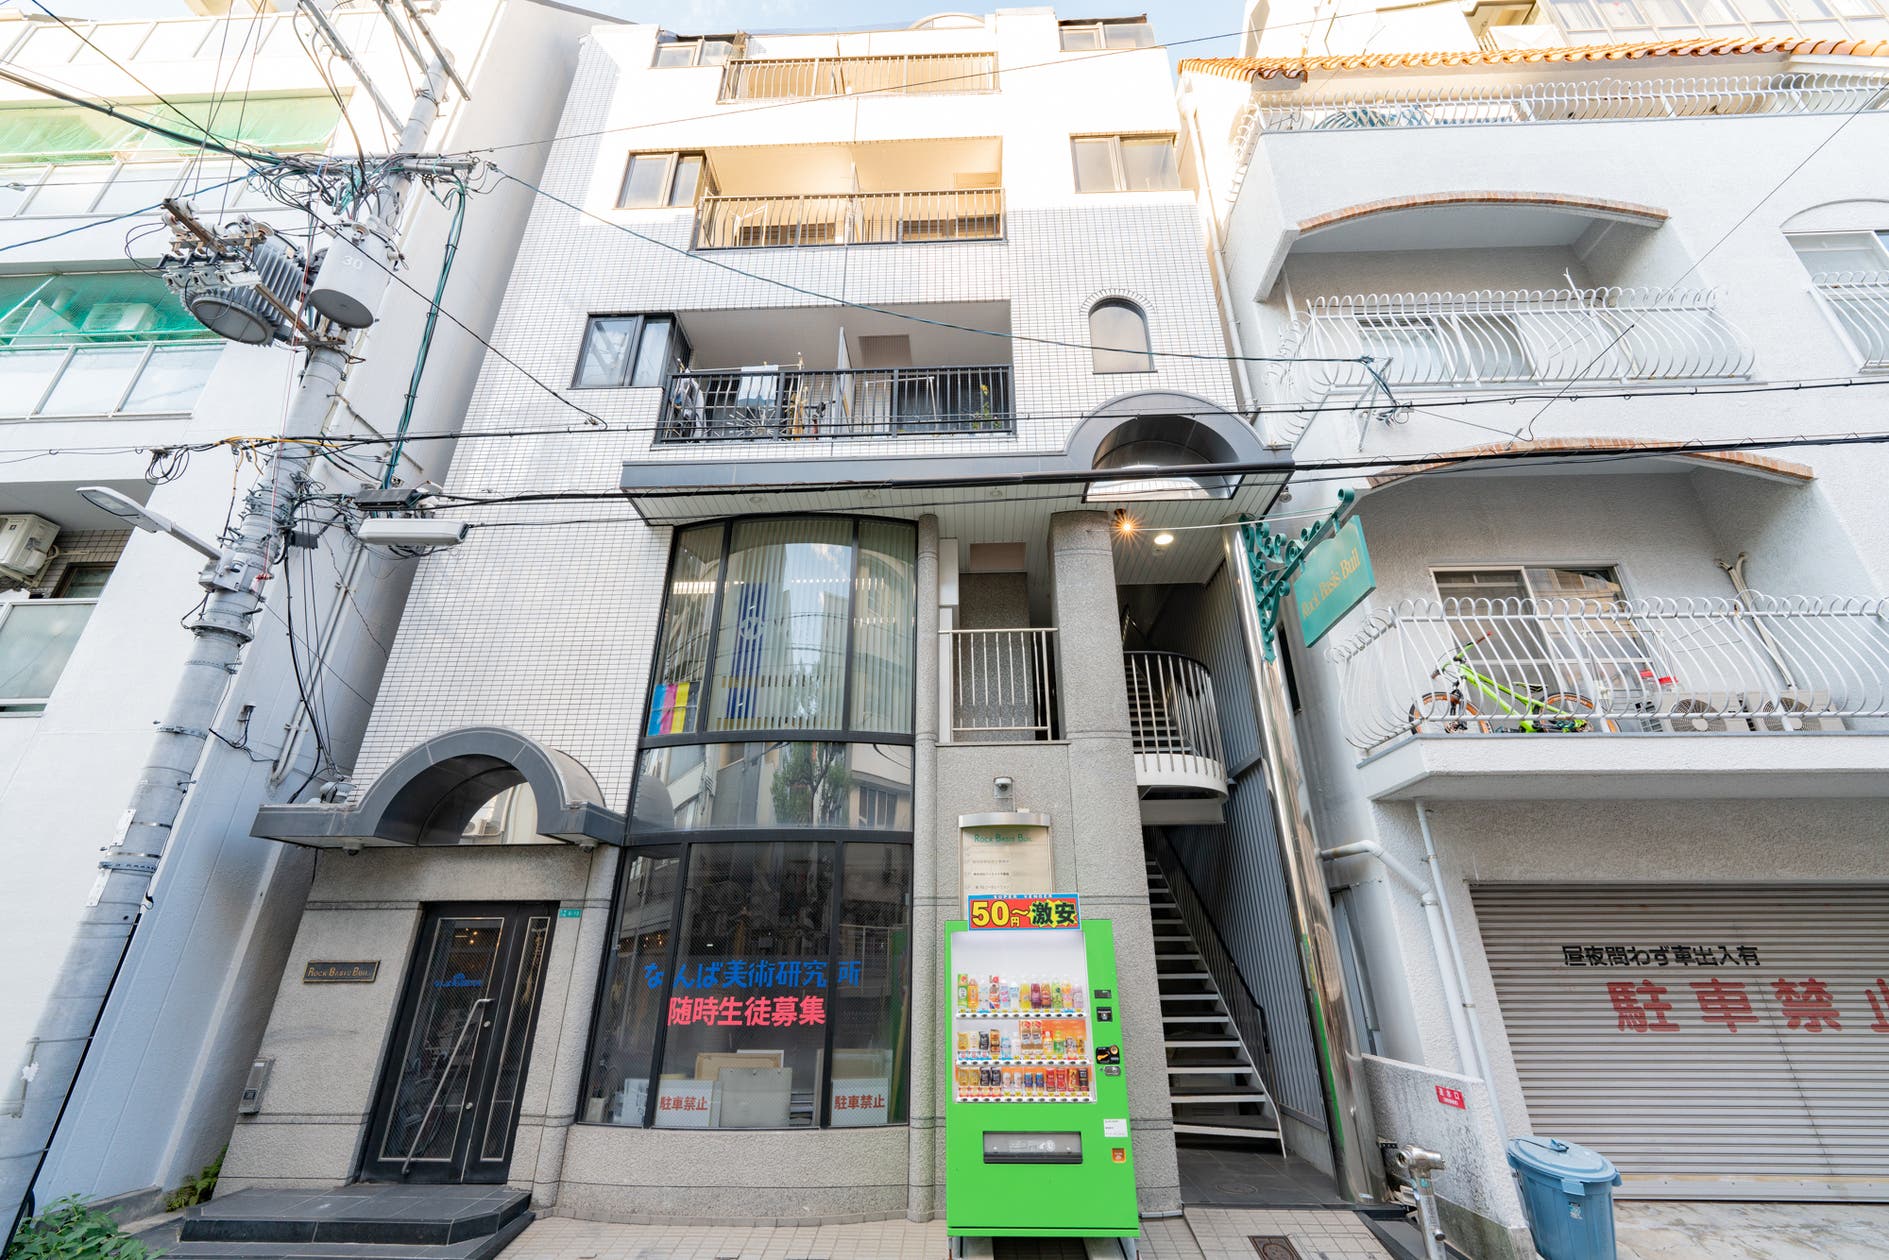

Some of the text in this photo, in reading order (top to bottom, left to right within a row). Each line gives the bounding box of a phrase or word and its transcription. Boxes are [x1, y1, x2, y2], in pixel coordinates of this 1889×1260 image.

[1562, 945, 1761, 967] 昼夜問わず車出入有
[643, 959, 862, 989] なんば美術研究所
[667, 995, 826, 1027] 随時生徒募集
[659, 1095, 708, 1111] 駐車禁止
[834, 1094, 885, 1111] 駐車禁止
